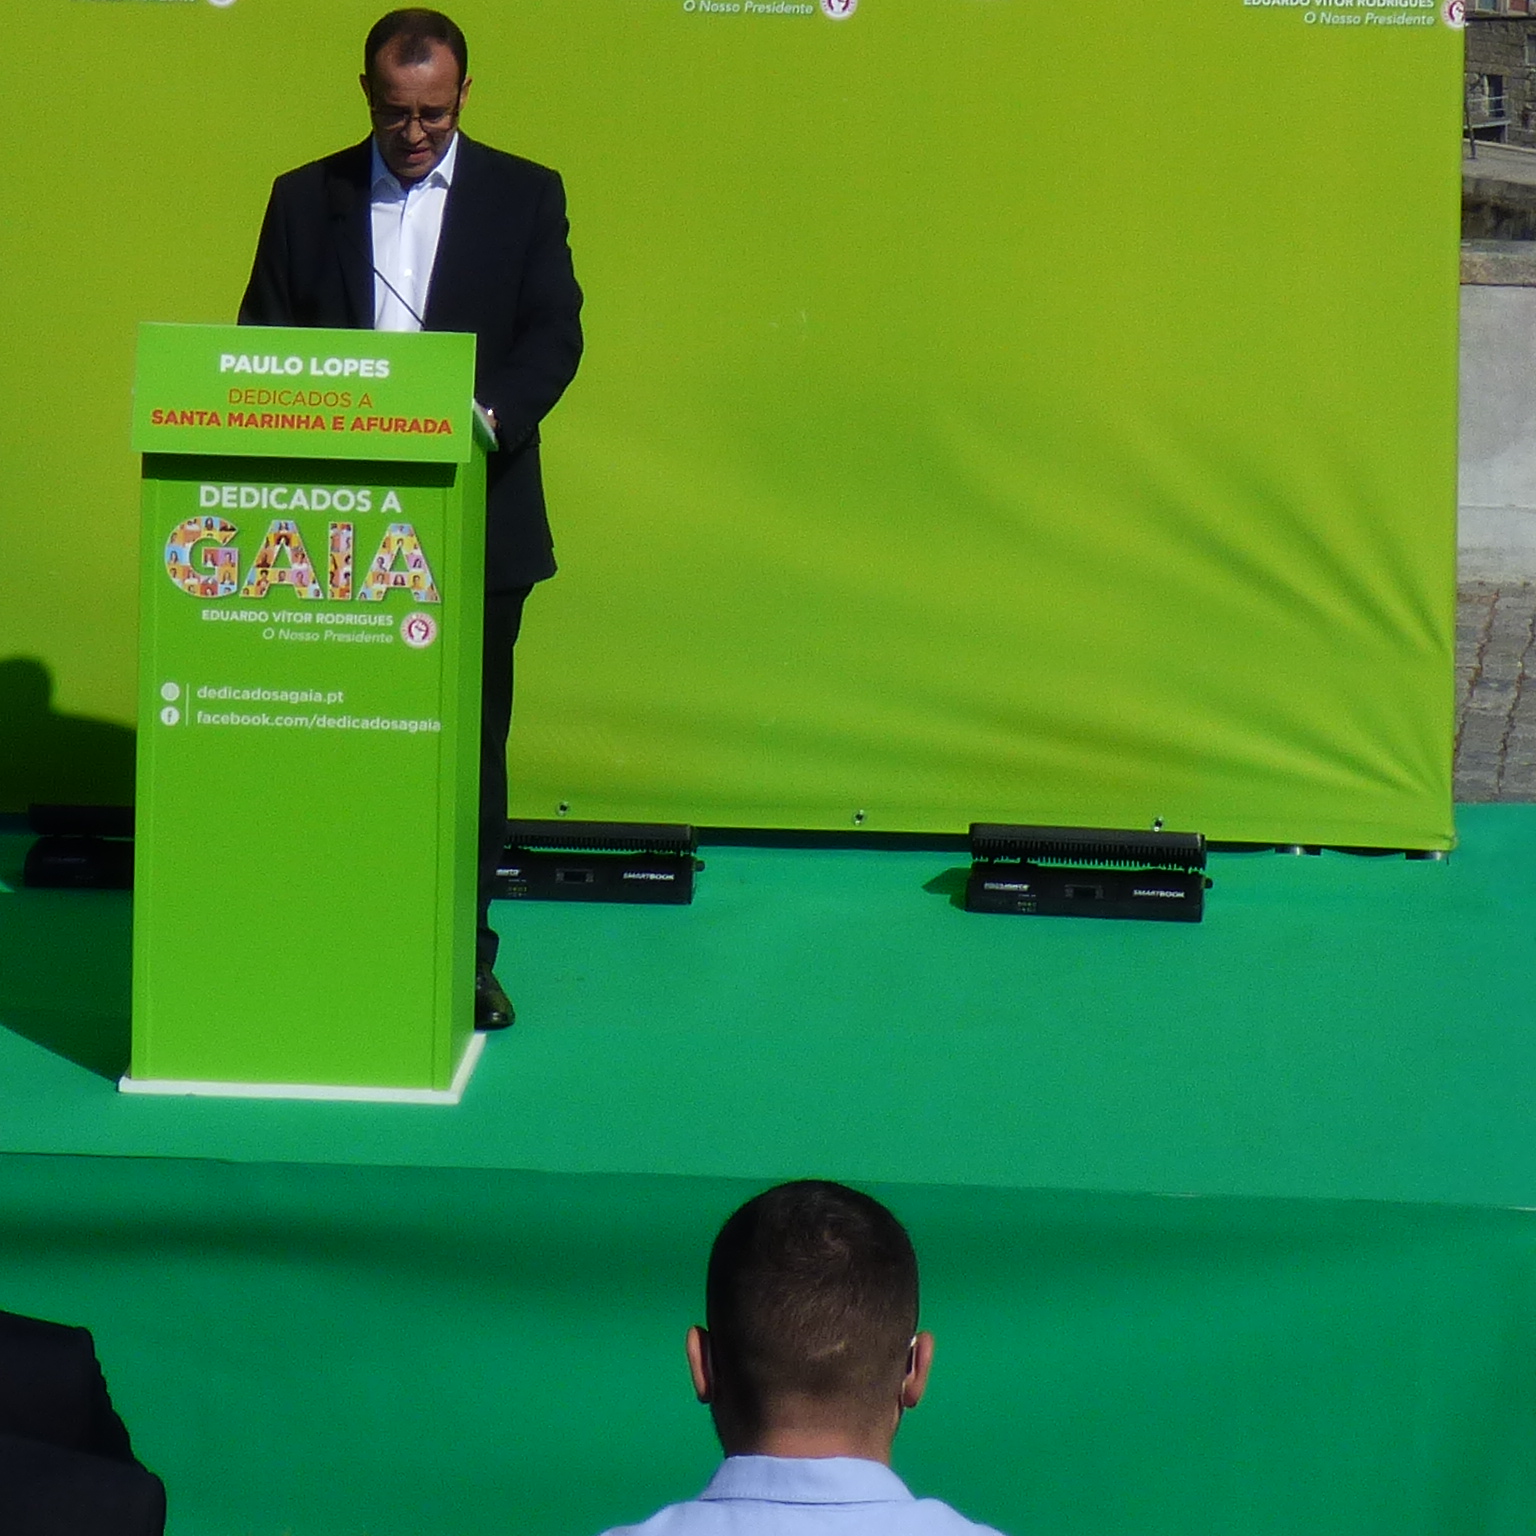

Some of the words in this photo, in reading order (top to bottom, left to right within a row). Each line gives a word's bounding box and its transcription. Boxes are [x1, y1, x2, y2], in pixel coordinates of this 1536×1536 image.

[684, 0, 695, 12] O
[699, 0, 740, 14] Nosso
[744, 0, 813, 15] Presidente
[1304, 12, 1316, 25] O
[1320, 12, 1361, 25] Nosso
[1365, 13, 1435, 26] Presidente
[220, 354, 303, 376] PAULO
[310, 357, 390, 378] LOPES
[228, 388, 352, 408] DEDICADOS
[358, 392, 373, 409] A
[151, 409, 222, 428] SANTA
[228, 412, 326, 431] MARINHA
[332, 415, 345, 431] E
[350, 416, 453, 435] AFURADA
[199, 485, 372, 512] DEDICADOS
[381, 491, 402, 513] A
[164, 516, 441, 603] GAIA
[202, 610, 269, 622] EDUARDO
[272, 610, 312, 624] VÍTOR
[316, 613, 394, 626] RODRIGUES
[263, 627, 274, 640] O
[279, 628, 319, 641] Nosso
[324, 629, 394, 644] Presidente
[197, 685, 344, 705] dedicadosagaia.pt
[197, 711, 442, 733] facebook.com/dedicadosagaia
